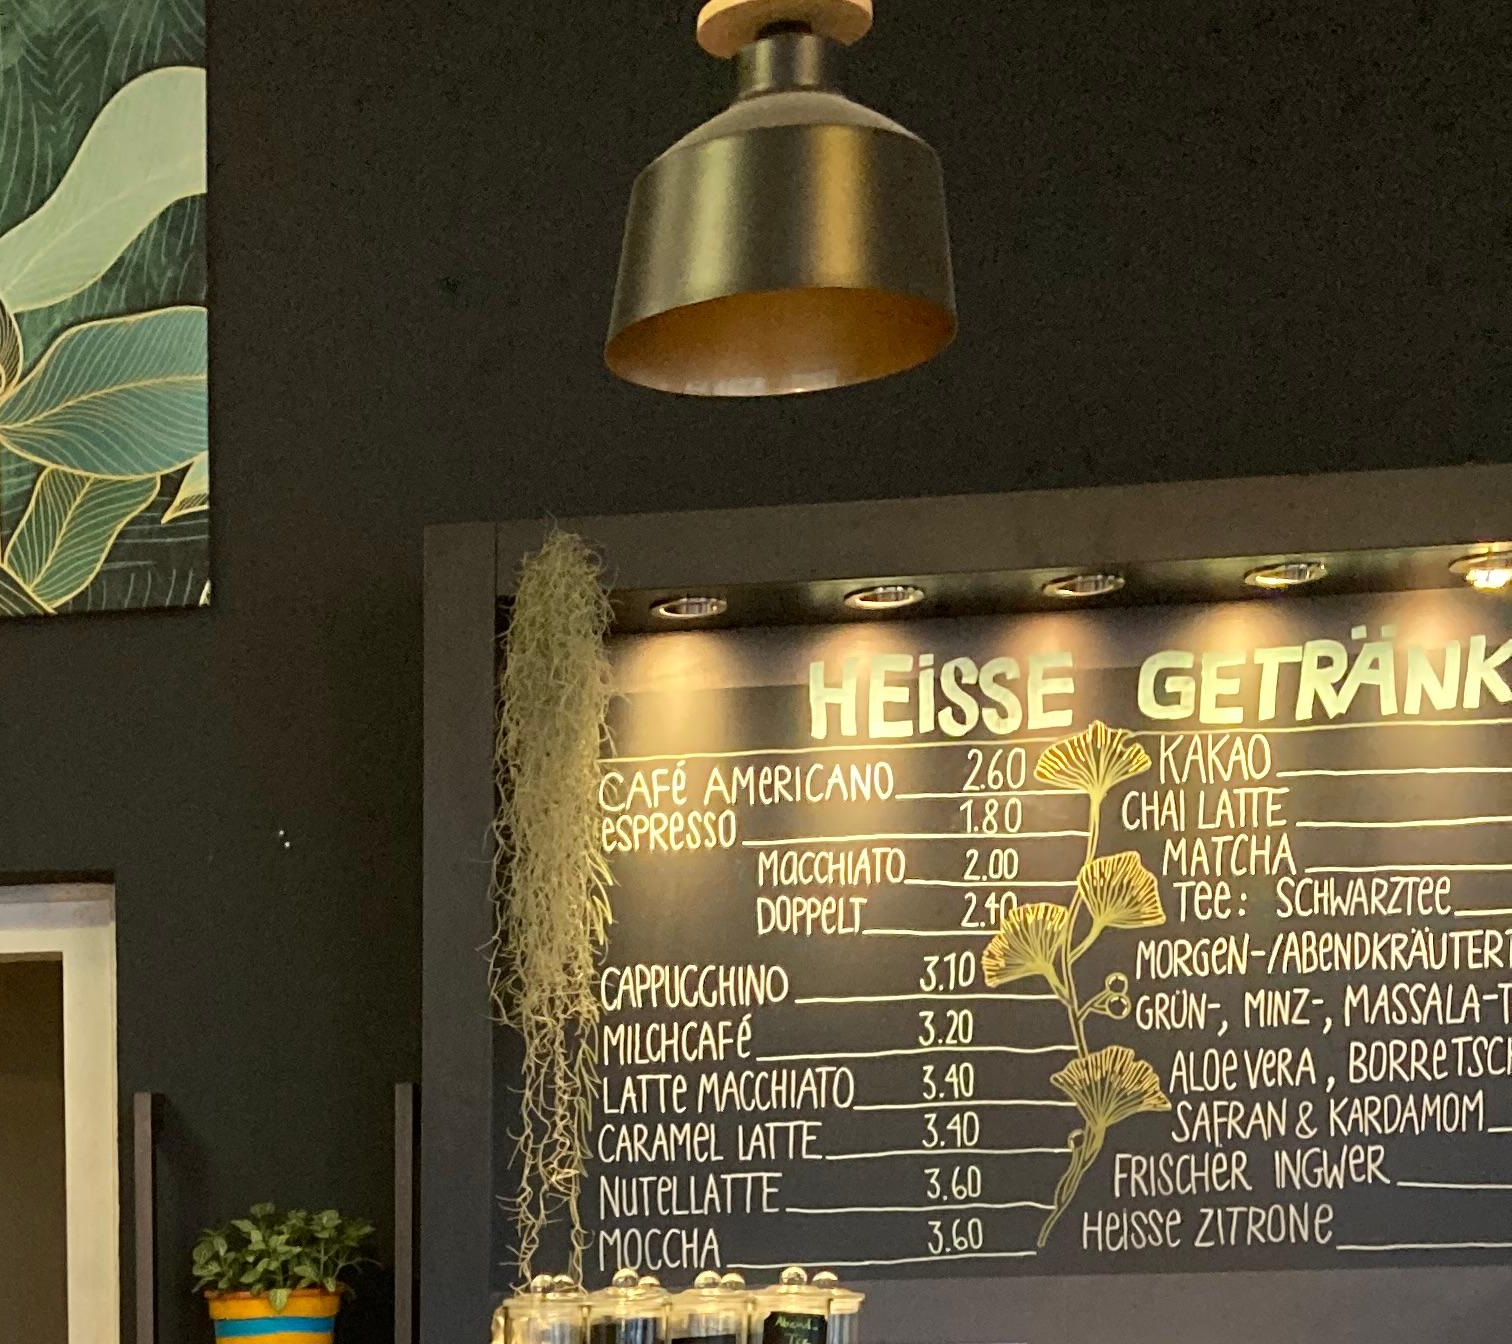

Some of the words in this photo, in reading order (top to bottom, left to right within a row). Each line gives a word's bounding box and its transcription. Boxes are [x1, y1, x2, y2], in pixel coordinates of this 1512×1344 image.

[963, 747, 1027, 792] 2.60
[1159, 733, 1271, 785] KAKAO
[959, 797, 1023, 834] 1.80
[1121, 789, 1185, 832] CHAI
[1198, 786, 1289, 830] LATTE
[963, 848, 1020, 881] 2.00
[1162, 833, 1297, 877] MATCHA
[600, 964, 789, 1012] CAPPUCCHINO
[919, 951, 977, 993] 3.10
[918, 1009, 974, 1046] 3.20
[697, 1066, 855, 1113] MACCHIATO
[922, 1062, 975, 1099] 3.40
[738, 1120, 823, 1161] LATTE
[922, 1111, 980, 1149] 3.40
[1170, 1097, 1287, 1147] SAFRAN
[1295, 1106, 1318, 1139] &
[1329, 1090, 1484, 1137] KARDAMOM
[924, 1165, 982, 1201] 3.60
[597, 1227, 722, 1272] MOCCHA
[926, 1218, 984, 1255] 3.60
